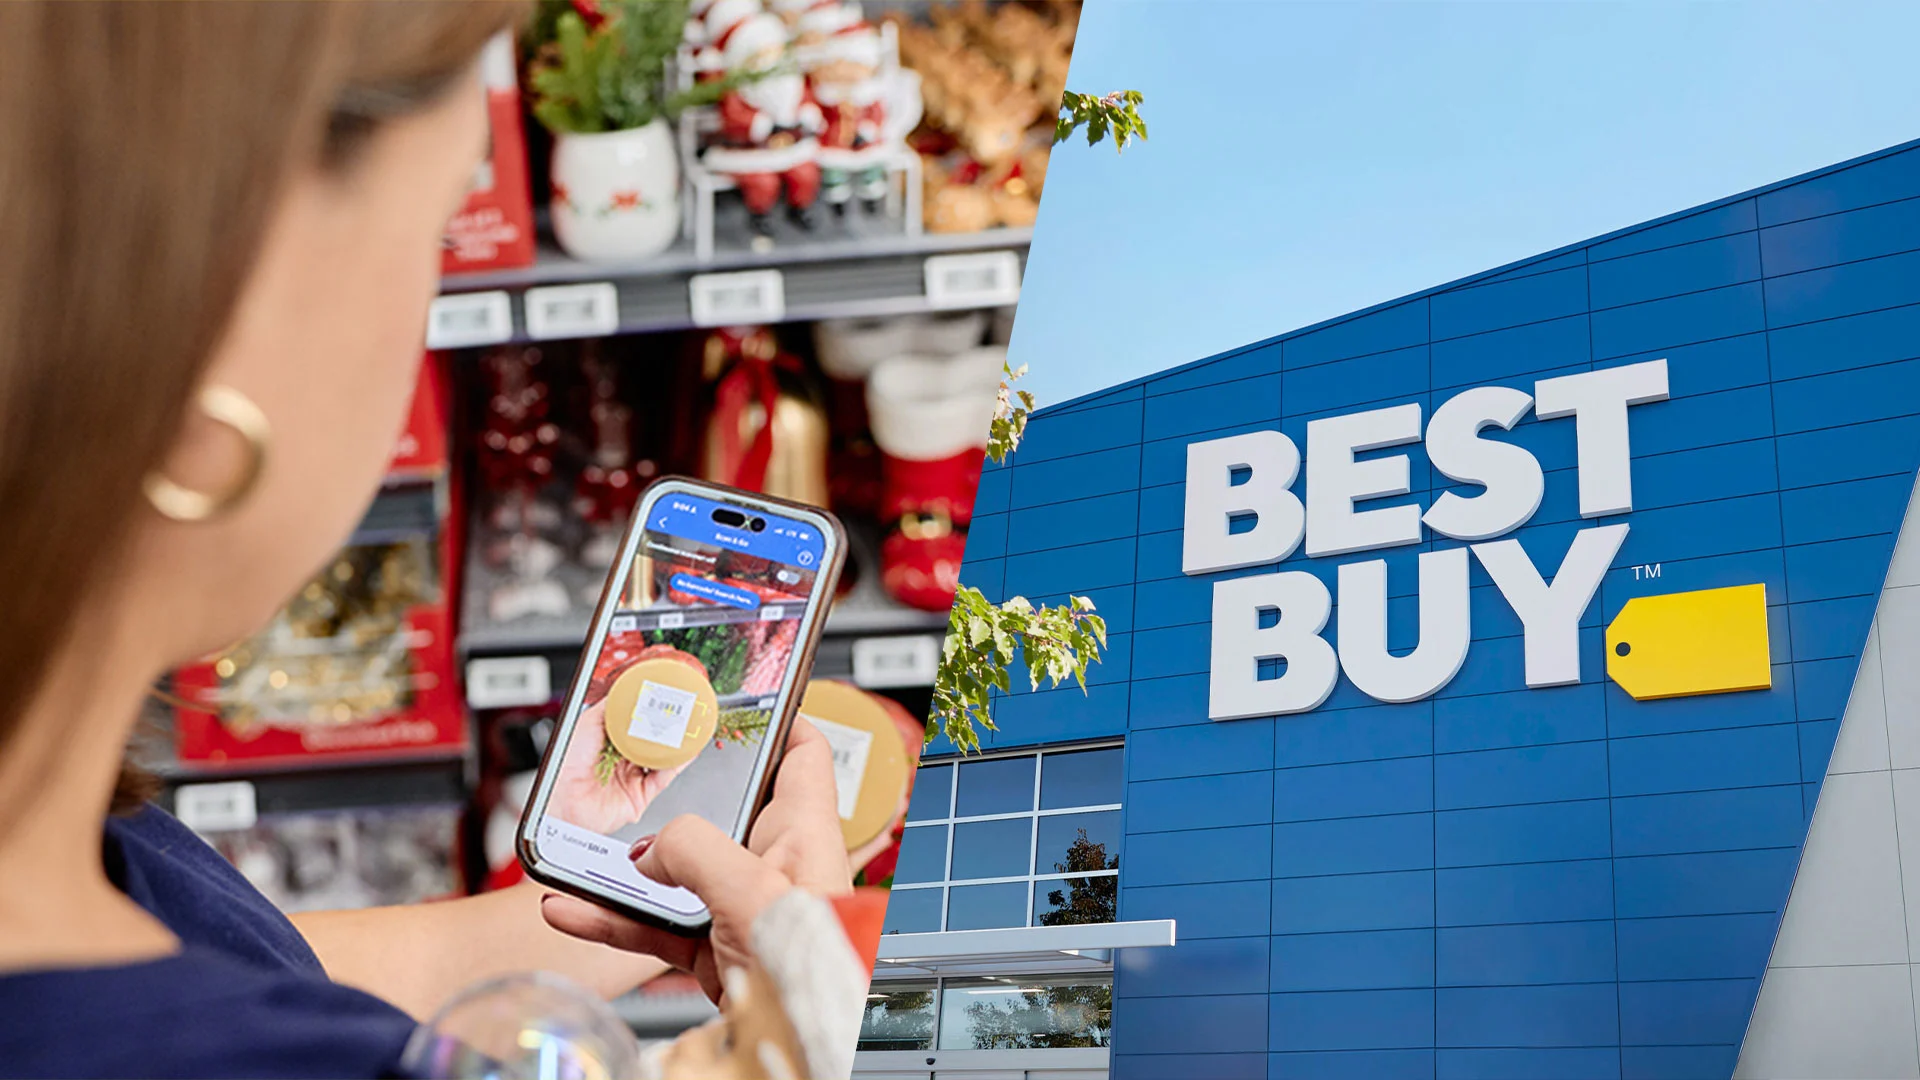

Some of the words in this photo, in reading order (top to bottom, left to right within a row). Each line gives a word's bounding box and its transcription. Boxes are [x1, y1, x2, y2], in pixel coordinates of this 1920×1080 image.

[1182, 358, 1671, 576] BEST
[1208, 523, 1631, 722] BUY
[1631, 563, 1661, 581] TM
